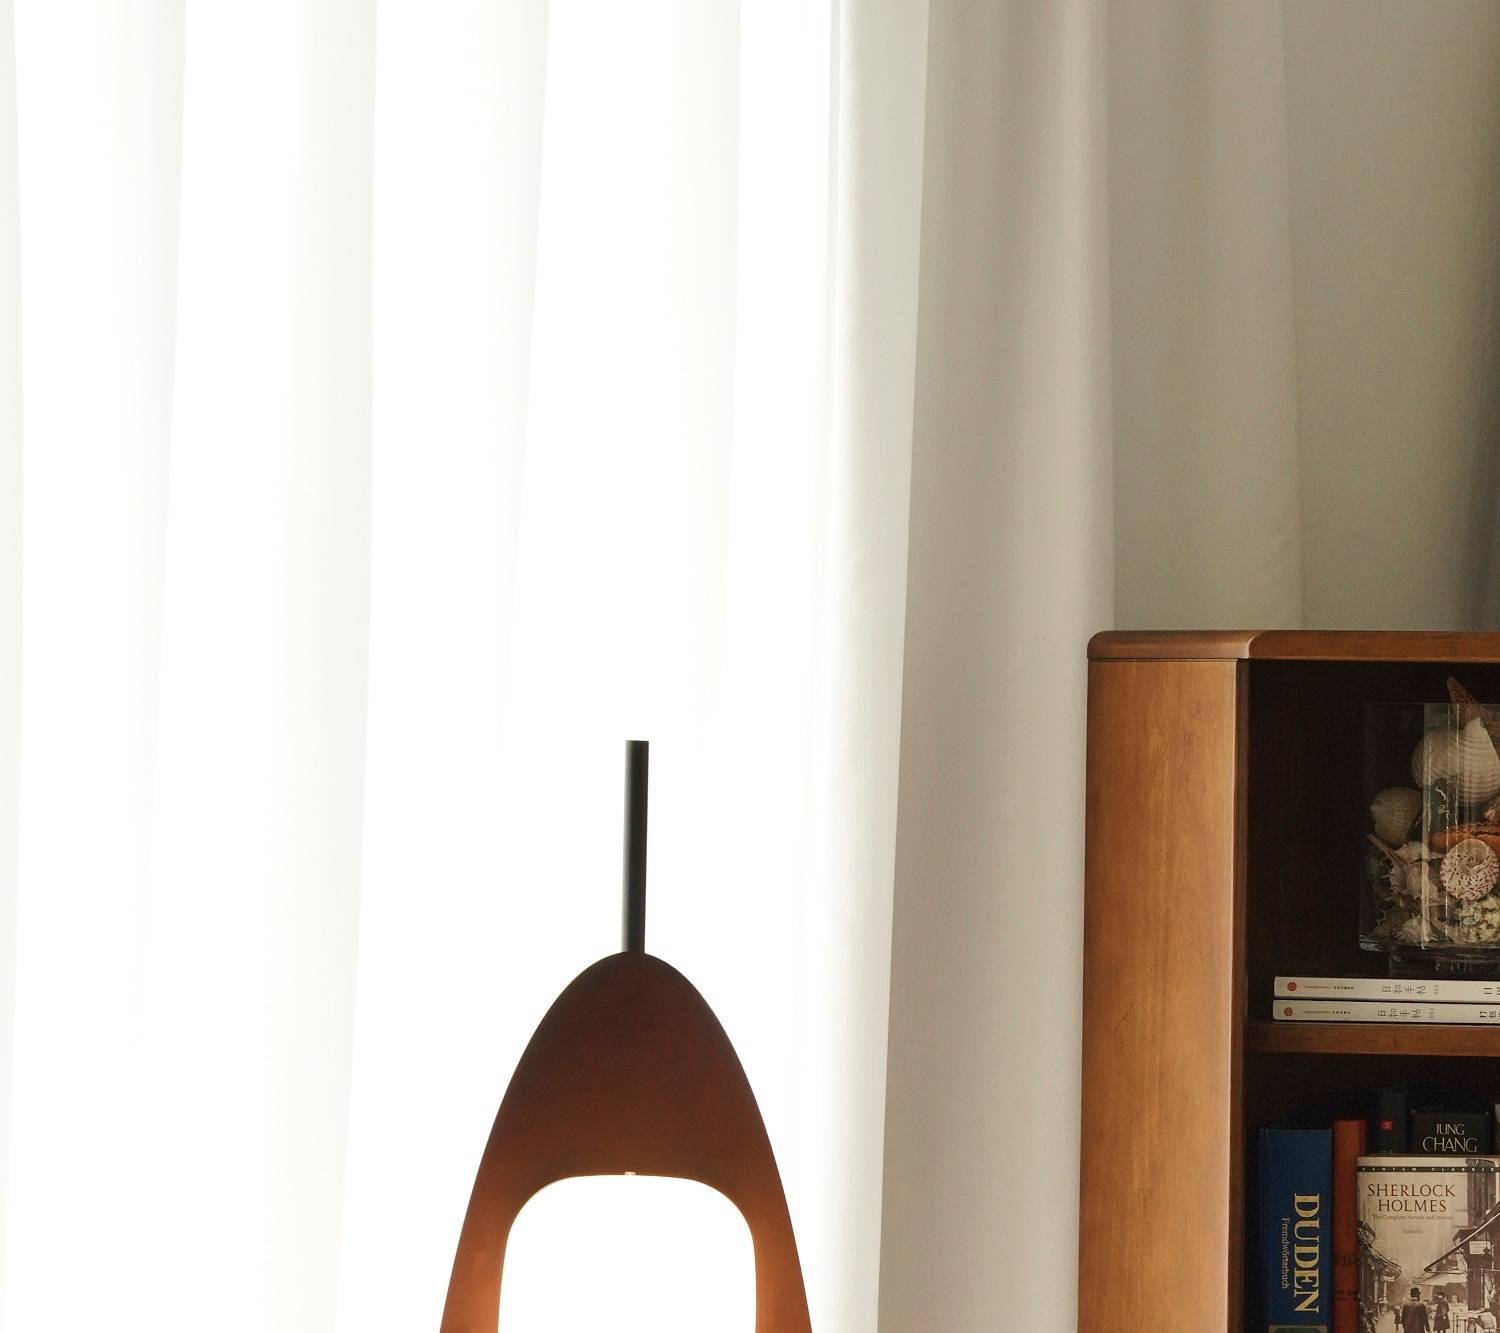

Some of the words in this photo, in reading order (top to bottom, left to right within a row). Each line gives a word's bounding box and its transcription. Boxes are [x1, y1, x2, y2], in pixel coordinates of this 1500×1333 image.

[1436, 1123, 1465, 1136] JUNG
[1422, 1136, 1479, 1153] CHANG
[1367, 1184, 1456, 1198] SHERLOCK
[1378, 1199, 1447, 1213] HOLMES
[1280, 1217, 1290, 1290] Fremdwörterbuch
[1294, 1193, 1320, 1313] DUDEN
